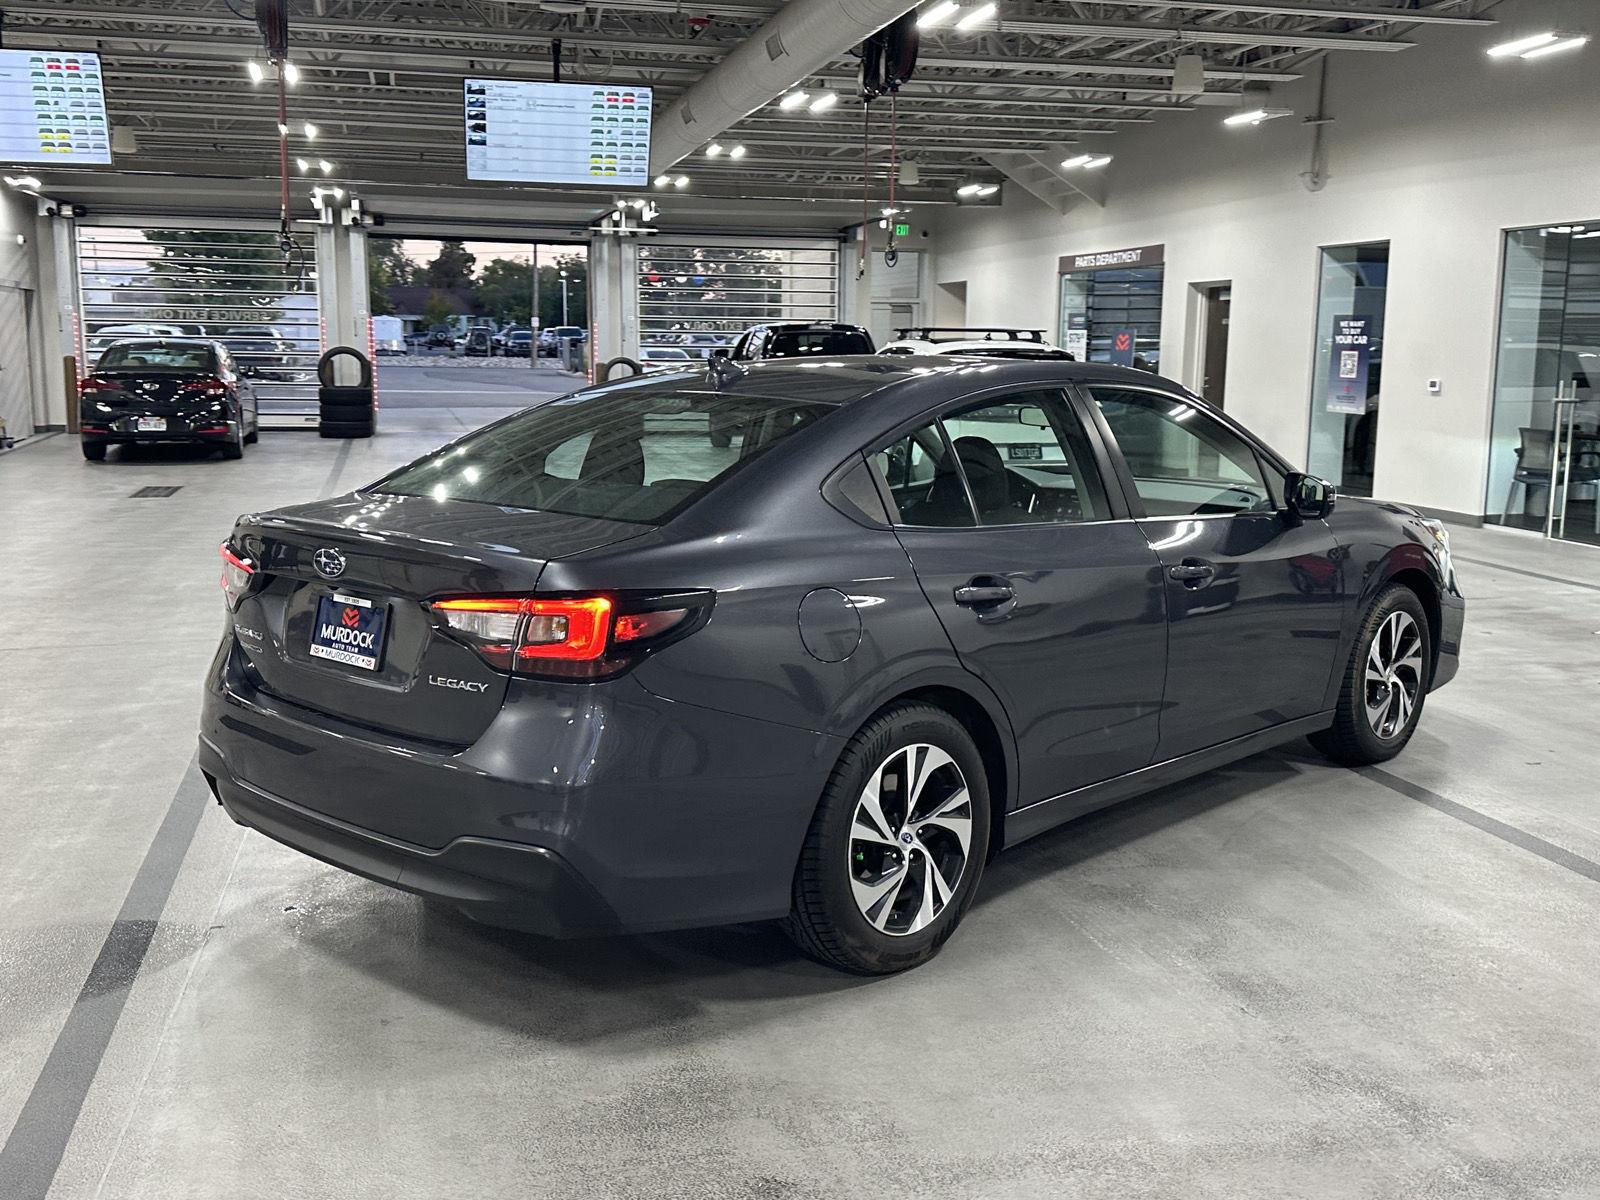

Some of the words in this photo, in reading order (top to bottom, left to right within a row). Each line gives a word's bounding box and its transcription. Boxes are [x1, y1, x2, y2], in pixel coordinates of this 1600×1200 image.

[1075, 255, 1096, 268] PARTS
[1096, 249, 1142, 266] DEPARTMENT
[1335, 335, 1352, 344] YOUR
[1353, 335, 1367, 344] CAR
[320, 623, 375, 649] MURDOCK
[331, 642, 345, 650] AUTO
[346, 645, 359, 653] TEAM
[325, 649, 360, 664] MURDOCK
[428, 674, 489, 693] LEGACY
